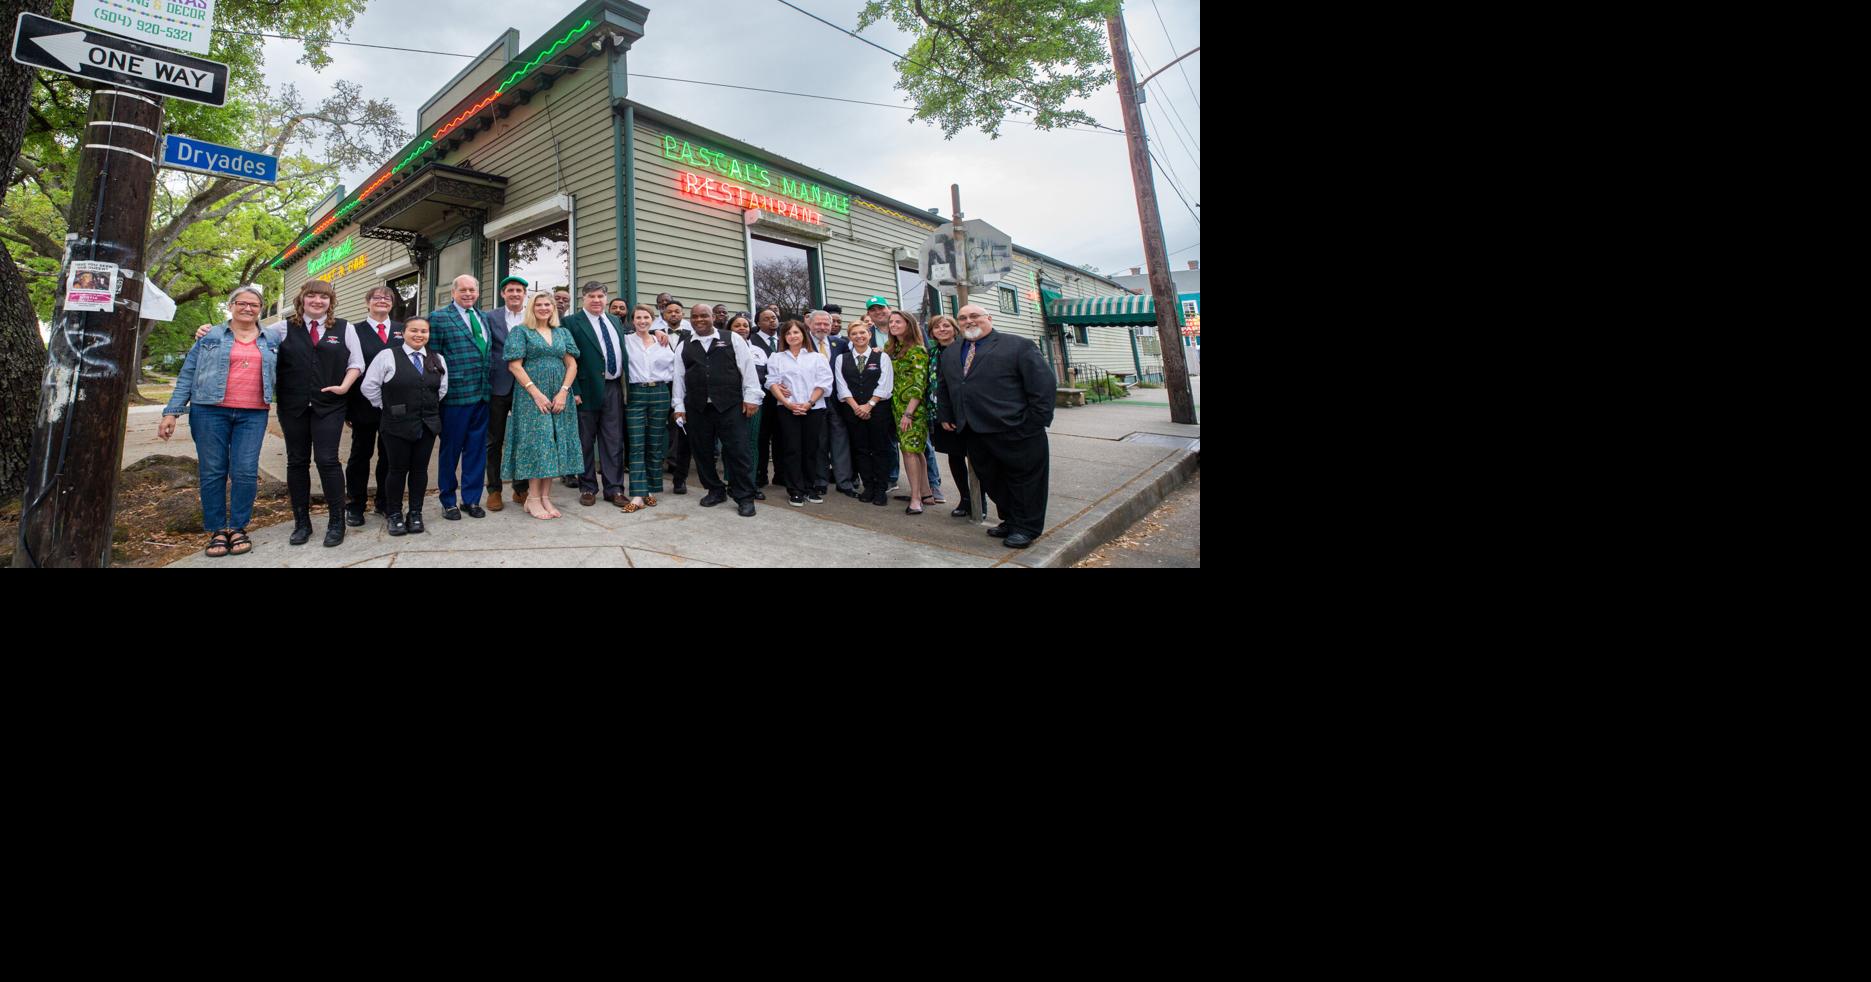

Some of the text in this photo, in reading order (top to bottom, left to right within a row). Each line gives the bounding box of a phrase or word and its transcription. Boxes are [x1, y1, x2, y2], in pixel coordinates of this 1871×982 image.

[94, 8, 192, 42] (504) 920-5321
[166, 3, 206, 20] DECOR
[88, 47, 208, 88] ONE WAY
[177, 142, 266, 176] Dryades
[665, 135, 771, 188] PASCAL'S
[685, 172, 822, 225] RESTAURANT
